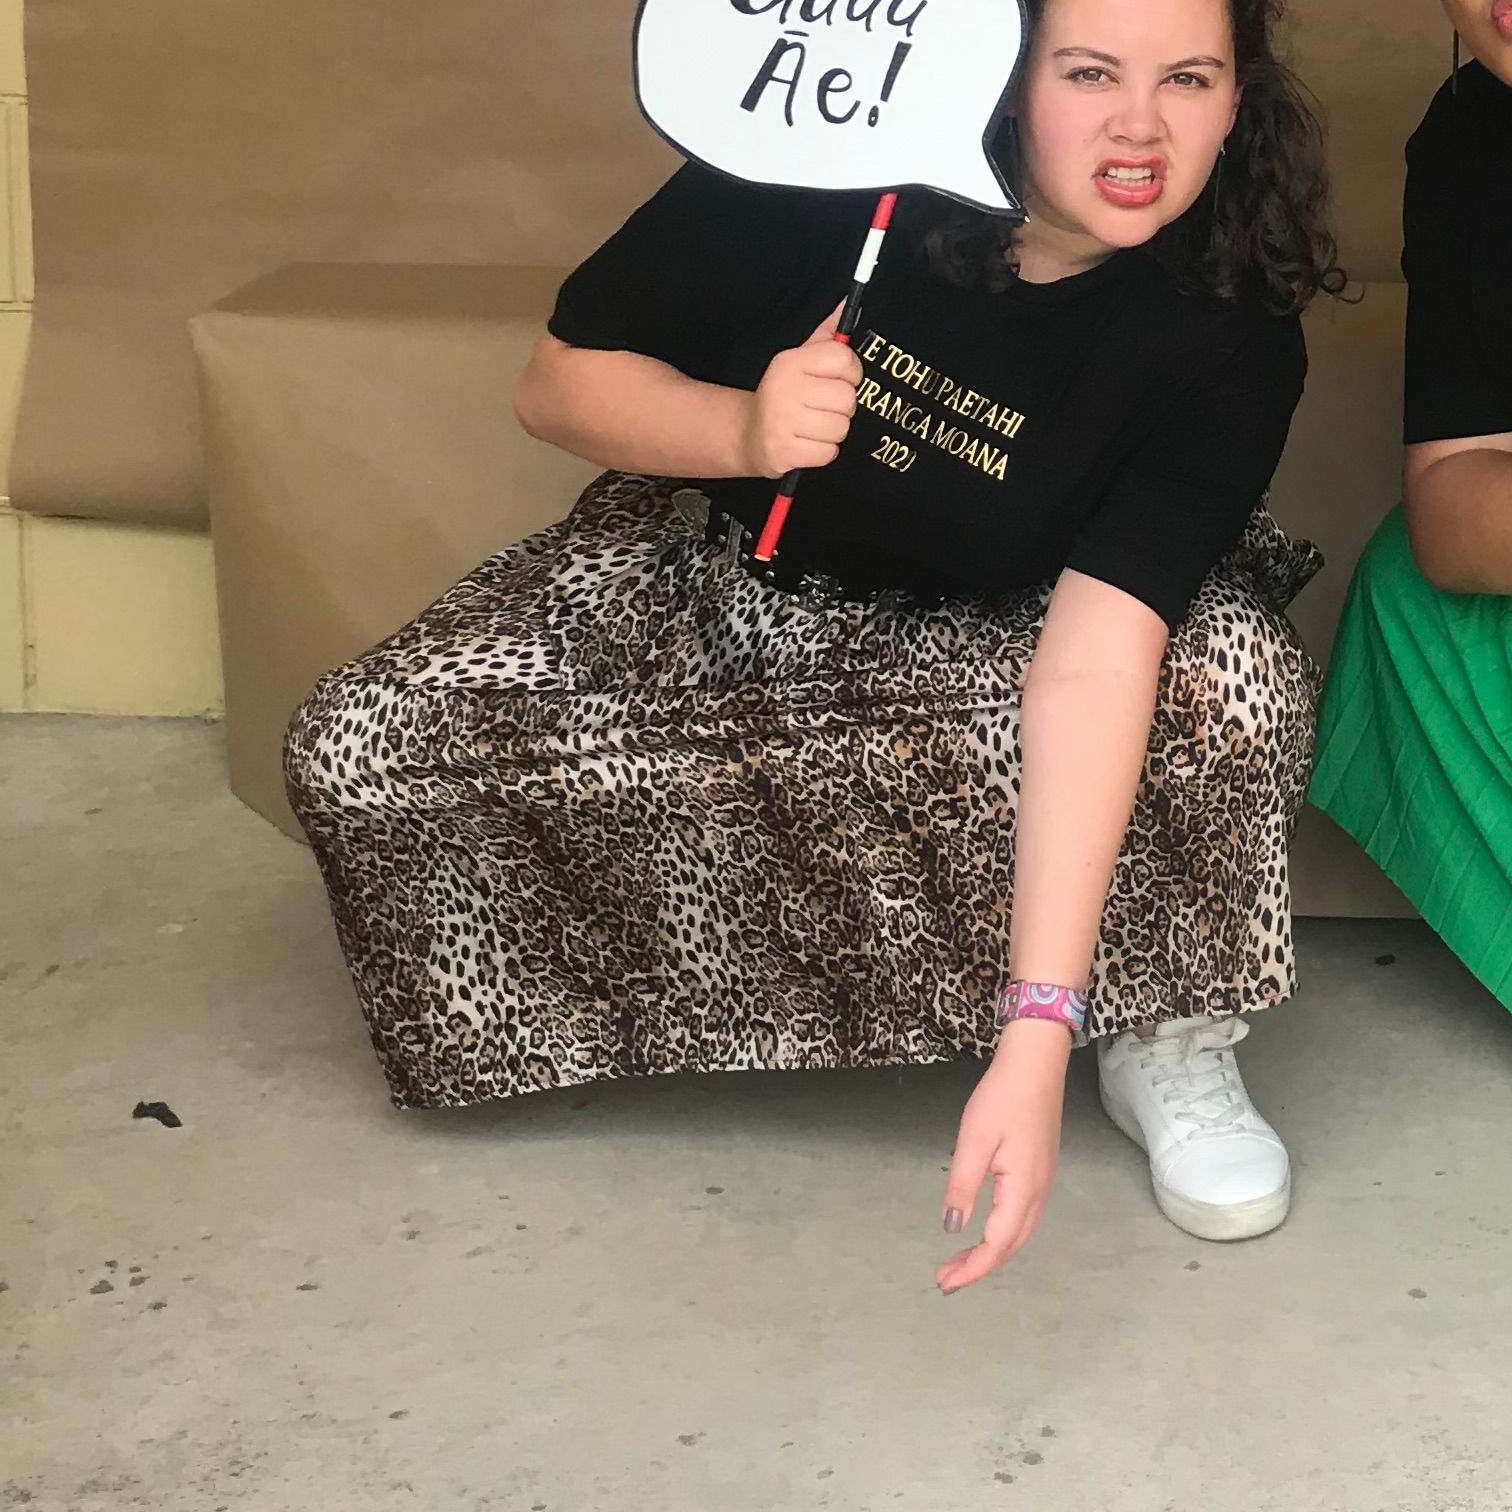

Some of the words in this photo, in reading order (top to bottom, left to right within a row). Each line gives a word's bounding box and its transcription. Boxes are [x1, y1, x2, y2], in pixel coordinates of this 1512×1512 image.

[740, 29, 912, 128] Āe!
[857, 329, 887, 362] TE
[881, 344, 942, 396] TOHU
[934, 377, 1026, 439] PAETAHI
[930, 420, 1009, 481] MOANA
